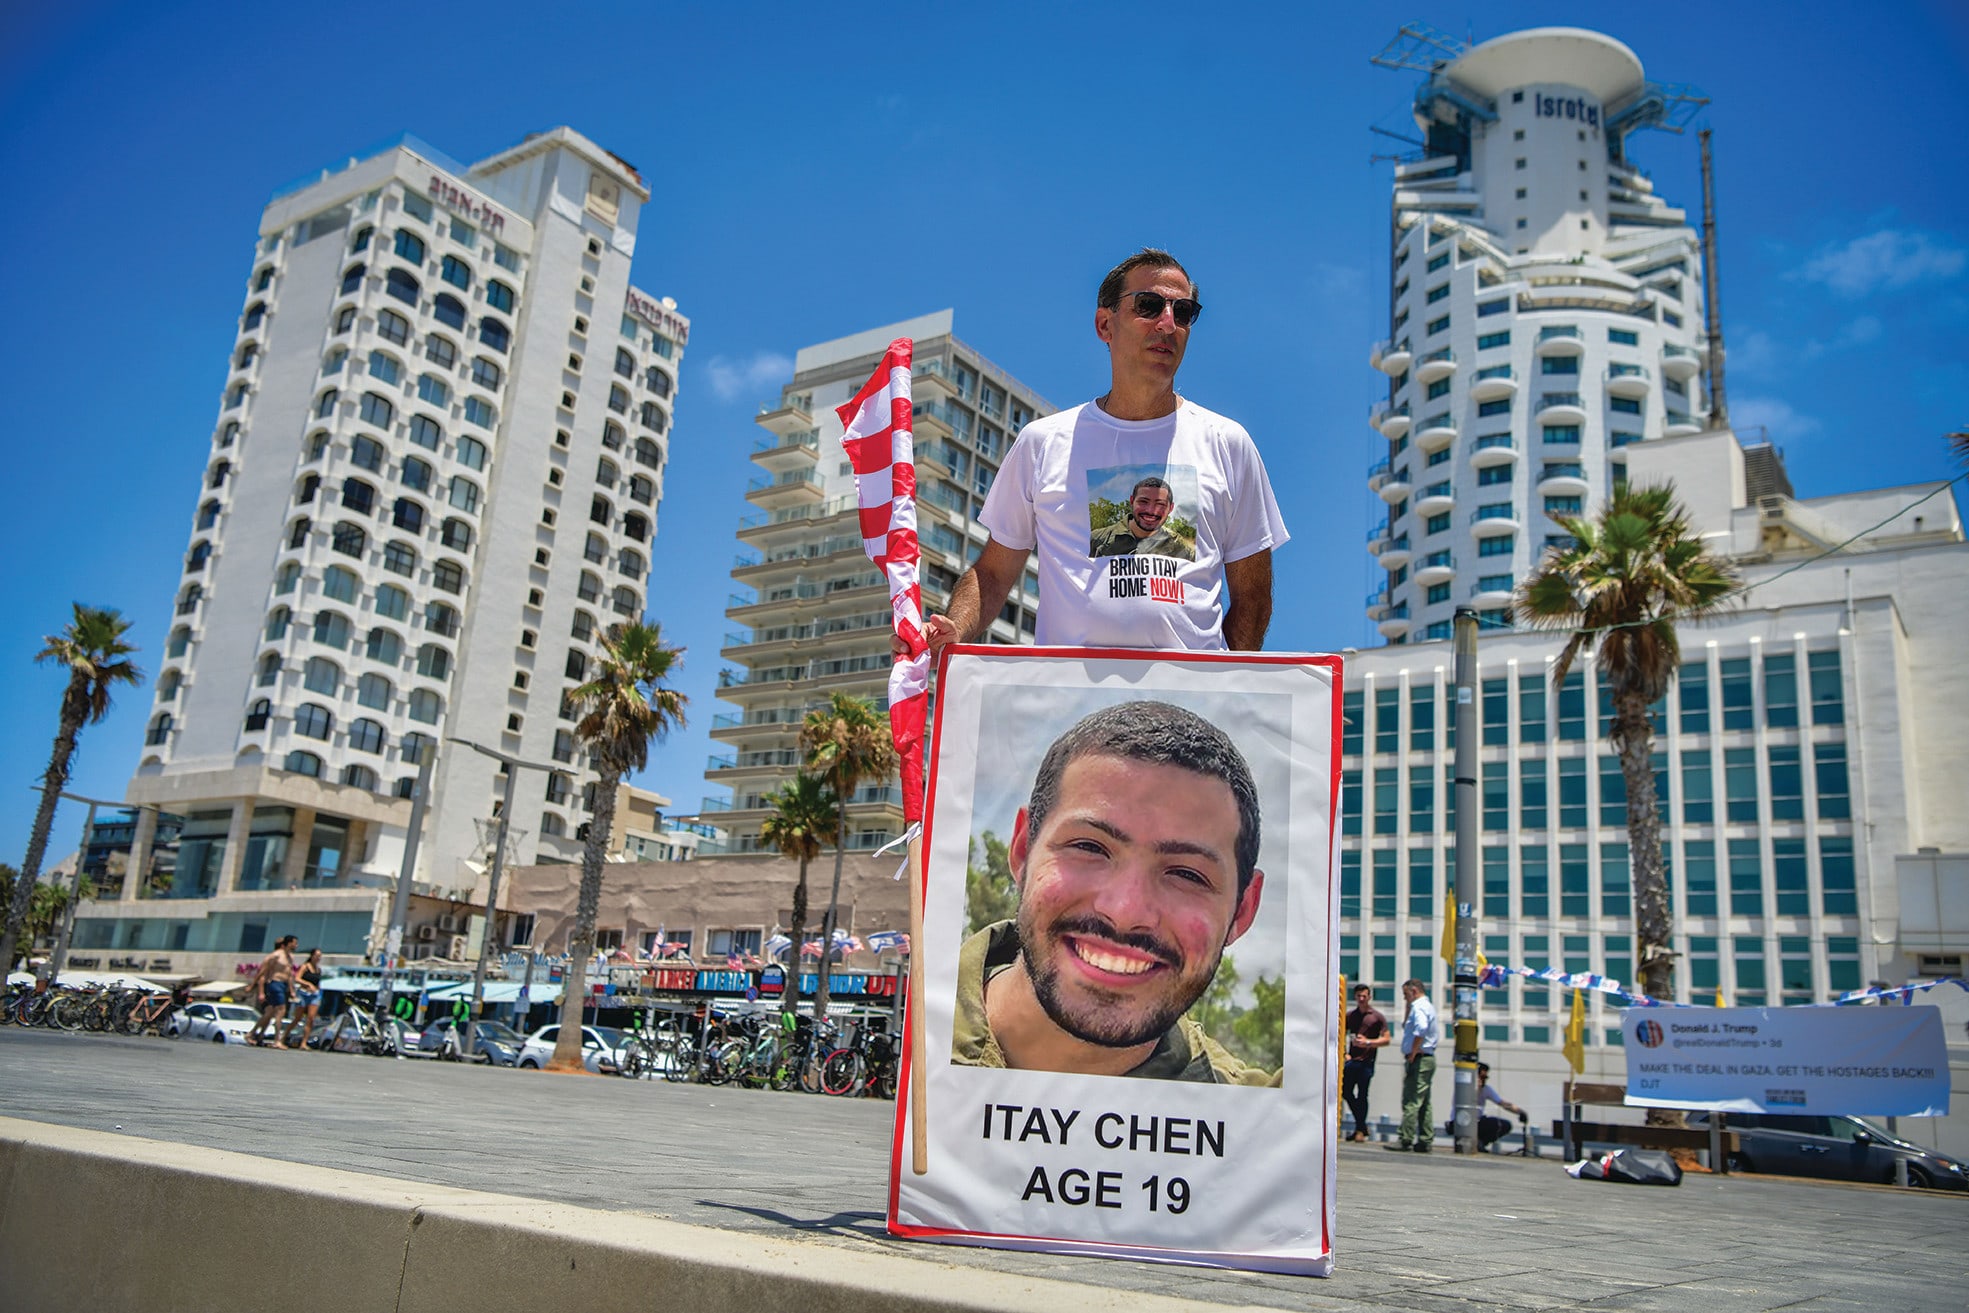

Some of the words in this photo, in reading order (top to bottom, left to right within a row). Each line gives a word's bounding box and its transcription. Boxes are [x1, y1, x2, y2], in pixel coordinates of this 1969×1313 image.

[1110, 557, 1149, 577] BRING
[1152, 557, 1178, 578] ITAY
[1109, 577, 1147, 598] HOME
[1150, 578, 1185, 605] NOW!
[696, 971, 753, 991] AMERICA
[1671, 1023, 1709, 1034] Donald
[1711, 1024, 1721, 1034] J.
[1723, 1024, 1758, 1036] Trump
[1673, 1038, 1760, 1049] @realDonaldTrump
[1639, 1063, 1669, 1074] MAKE
[1673, 1064, 1695, 1074] THE
[1696, 1064, 1723, 1075] DEAL
[1727, 1064, 1739, 1075] IN
[1742, 1065, 1773, 1076] GAZA.
[1776, 1066, 1799, 1077] GET
[1803, 1066, 1825, 1077] THE
[1828, 1067, 1890, 1078] HOSTAGES
[1640, 1079, 1661, 1089] DJT
[982, 1103, 1080, 1146] ITAY
[1094, 1112, 1225, 1158] CHEN
[1021, 1166, 1123, 1209] AGE
[1141, 1174, 1191, 1215] 19
